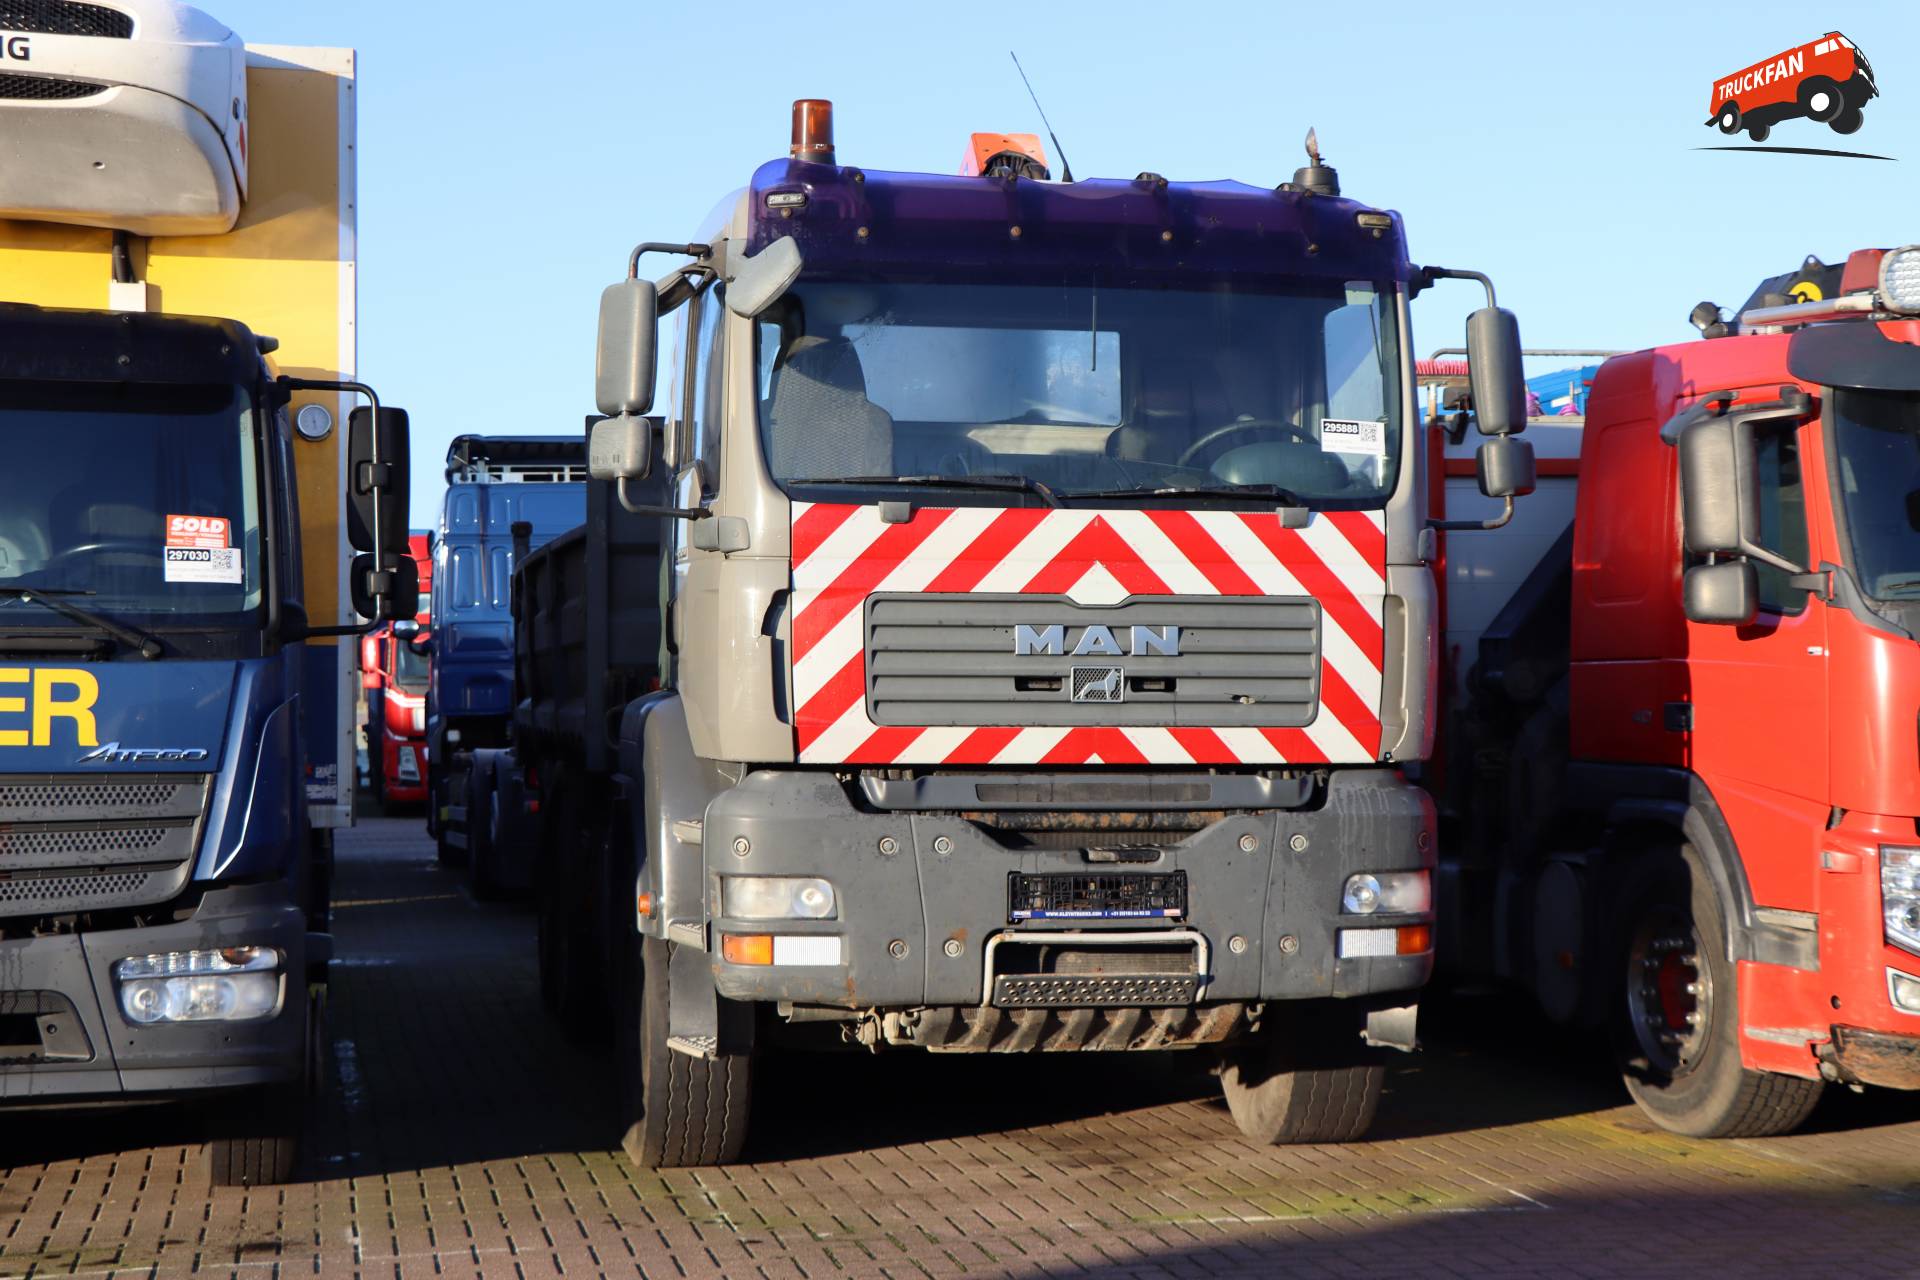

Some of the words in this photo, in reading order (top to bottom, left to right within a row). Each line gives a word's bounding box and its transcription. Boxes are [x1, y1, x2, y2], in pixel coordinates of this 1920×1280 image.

[1323, 422, 1359, 434] 295888
[170, 517, 225, 534] SOLD
[168, 550, 209, 560] 297030
[1015, 624, 1179, 656] MAN
